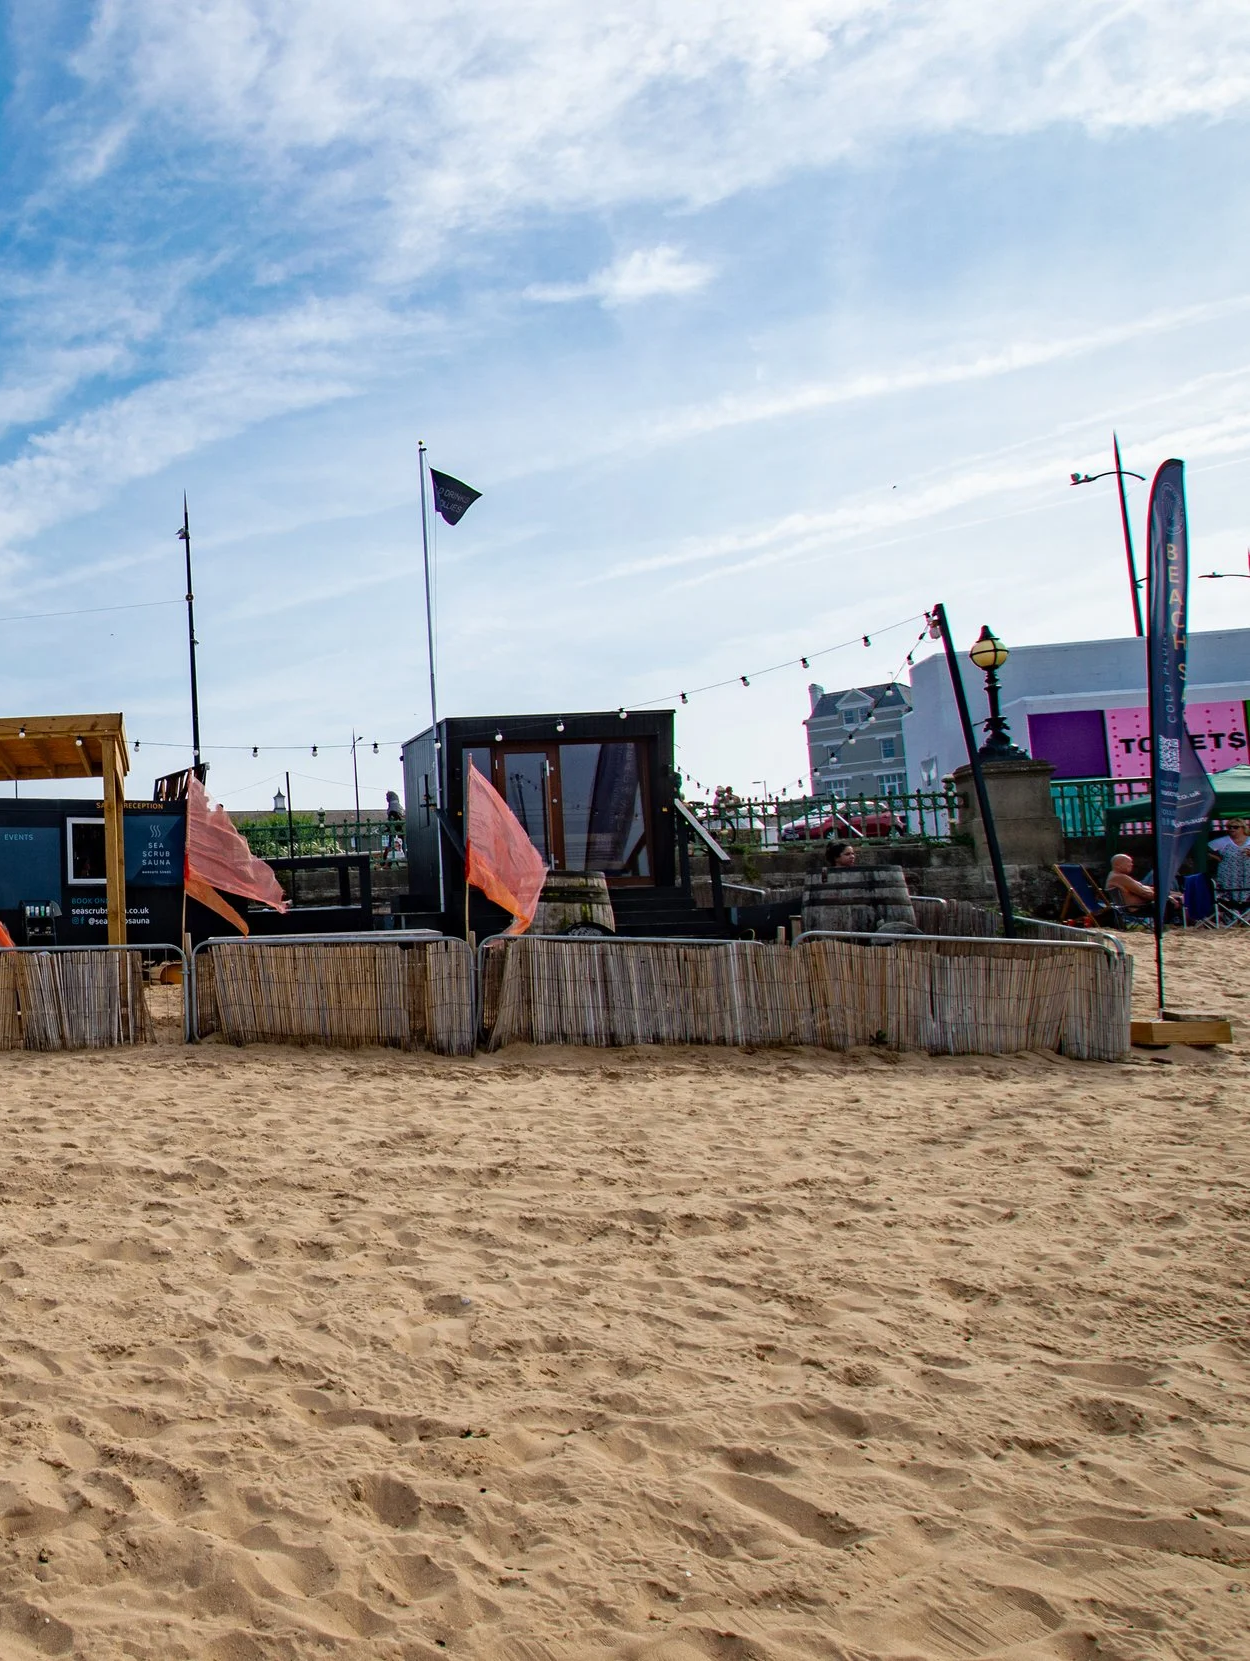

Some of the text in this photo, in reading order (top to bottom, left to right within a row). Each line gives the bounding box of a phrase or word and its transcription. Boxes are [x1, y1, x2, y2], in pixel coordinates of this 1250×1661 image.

[1166, 543, 1187, 651] BEACH
[1164, 684, 1177, 724] COLD
[1119, 731, 1247, 754] TOETS
[4, 833, 34, 841] EVENTS
[71, 897, 93, 905] BOOK
[71, 907, 149, 915] seascrubs.co.uk
[88, 917, 150, 926] @seasauna
